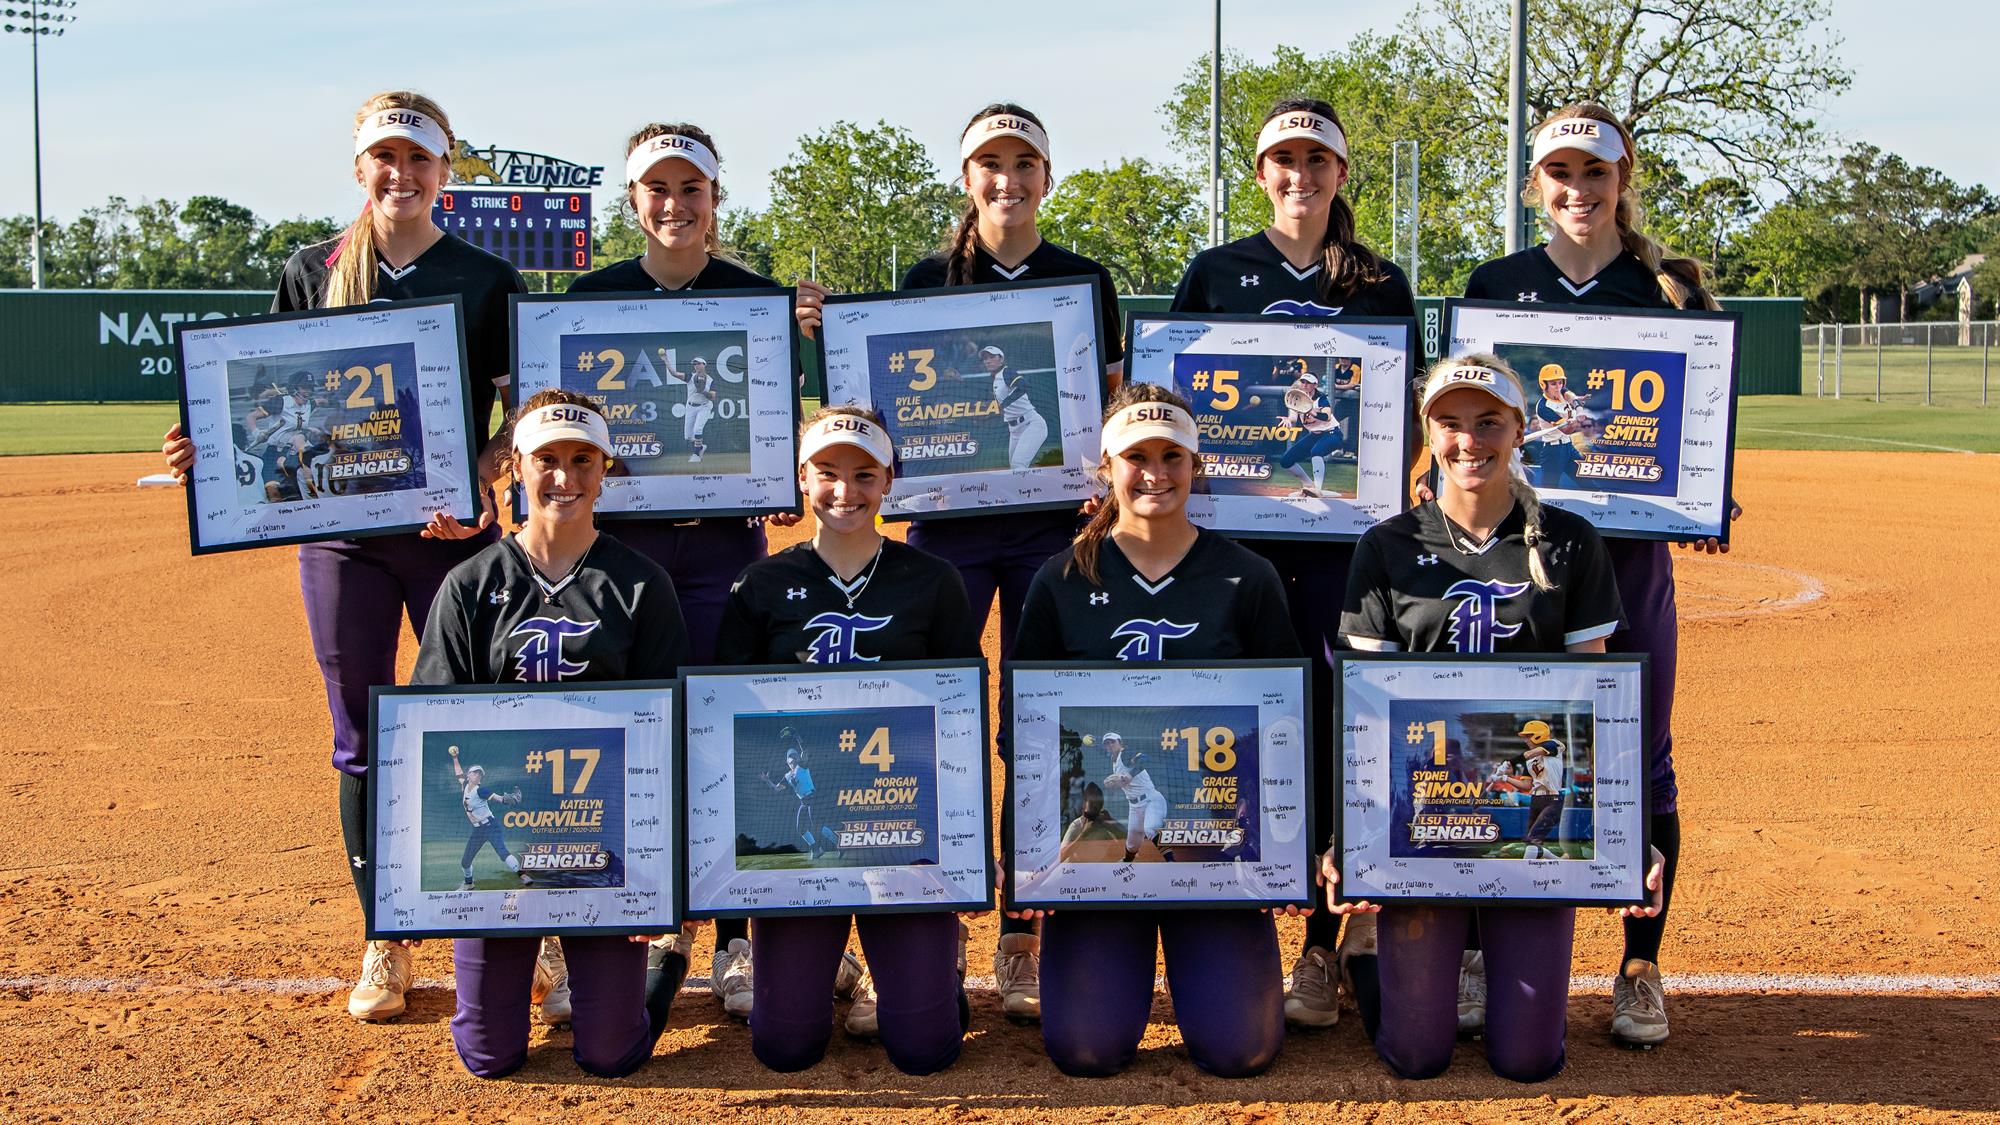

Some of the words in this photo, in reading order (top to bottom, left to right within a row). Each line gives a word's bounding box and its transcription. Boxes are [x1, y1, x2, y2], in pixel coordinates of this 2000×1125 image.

[378, 113, 423, 128] LSUE
[986, 118, 1032, 133] LSUE
[1278, 117, 1324, 132] LSUE
[1550, 124, 1598, 138] LSUE
[650, 138, 696, 154] LSUE
[508, 165, 604, 187] EUNICE
[471, 197, 508, 209] STRIKE
[511, 195, 521, 211] 0
[544, 197, 565, 210] OUT
[570, 196, 579, 212] 0
[443, 218, 448, 228] 1
[459, 218, 465, 228] 2
[476, 218, 482, 228] 3
[494, 218, 500, 228] 4
[511, 218, 517, 228] 5
[527, 218, 533, 228] 6
[545, 218, 551, 228] 7
[560, 219, 586, 229] RUNS
[575, 232, 584, 247] 0
[575, 251, 584, 267] 0
[578, 349, 625, 390] #2
[716, 346, 744, 383] C
[889, 349, 936, 391] #3
[1442, 370, 1492, 385] LSUE
[325, 363, 395, 408] #21
[1192, 370, 1240, 411] #5
[1586, 369, 1664, 412] #10
[896, 396, 920, 406] RYLIE
[370, 409, 400, 421] OLIVIA
[540, 409, 590, 425] LSUE
[642, 402, 657, 421] 3
[897, 400, 1000, 422] CANDELLA
[1126, 408, 1174, 425] LSUE
[1196, 414, 1224, 424] KARLI
[1614, 416, 1658, 426] KENNEDY
[331, 420, 401, 440] HENNEN
[822, 420, 870, 436] LSUE
[1198, 424, 1303, 442] FONTENOT
[1603, 425, 1658, 442] SMITH
[347, 437, 372, 445] CATCHER
[615, 435, 652, 443] EUNICE
[908, 436, 926, 446] LSU
[931, 434, 968, 444] EUNICE
[1590, 438, 1624, 446] OUTFIELDER
[338, 454, 357, 464] LSU
[362, 450, 399, 462] EUNICE
[902, 442, 976, 460] BENGALS
[1201, 454, 1220, 462] LSU
[1224, 456, 1263, 464] EUNICE
[1588, 455, 1607, 463] LSU
[1612, 456, 1652, 466] EUNICE
[332, 458, 409, 478] BENGALS
[1580, 462, 1661, 480] BENGALS
[838, 727, 894, 772] #4
[1161, 726, 1236, 772] #18
[1406, 720, 1446, 765] #1
[526, 749, 600, 794] #17
[1412, 771, 1449, 781] SYDNEI
[874, 776, 917, 787] MORGAN
[1202, 776, 1238, 786] GRACIE
[838, 788, 918, 806] HARLOW
[1193, 788, 1238, 803] KING
[1413, 782, 1482, 798] SIMON
[560, 800, 604, 810] KATELYN
[504, 810, 604, 828] COURVILLE
[846, 822, 868, 832] LSU
[872, 821, 914, 831] EUNICE
[1168, 821, 1188, 830] LSU
[1194, 821, 1234, 830] EUNICE
[1420, 816, 1442, 824] LSU
[1446, 816, 1488, 825] EUNICE
[840, 830, 922, 846] BENGALS
[1160, 830, 1242, 844] BENGALS
[1412, 826, 1497, 840] BENGALS
[531, 844, 552, 854] LSU
[558, 844, 597, 854] EUNICE
[522, 854, 608, 868] BENGALS
